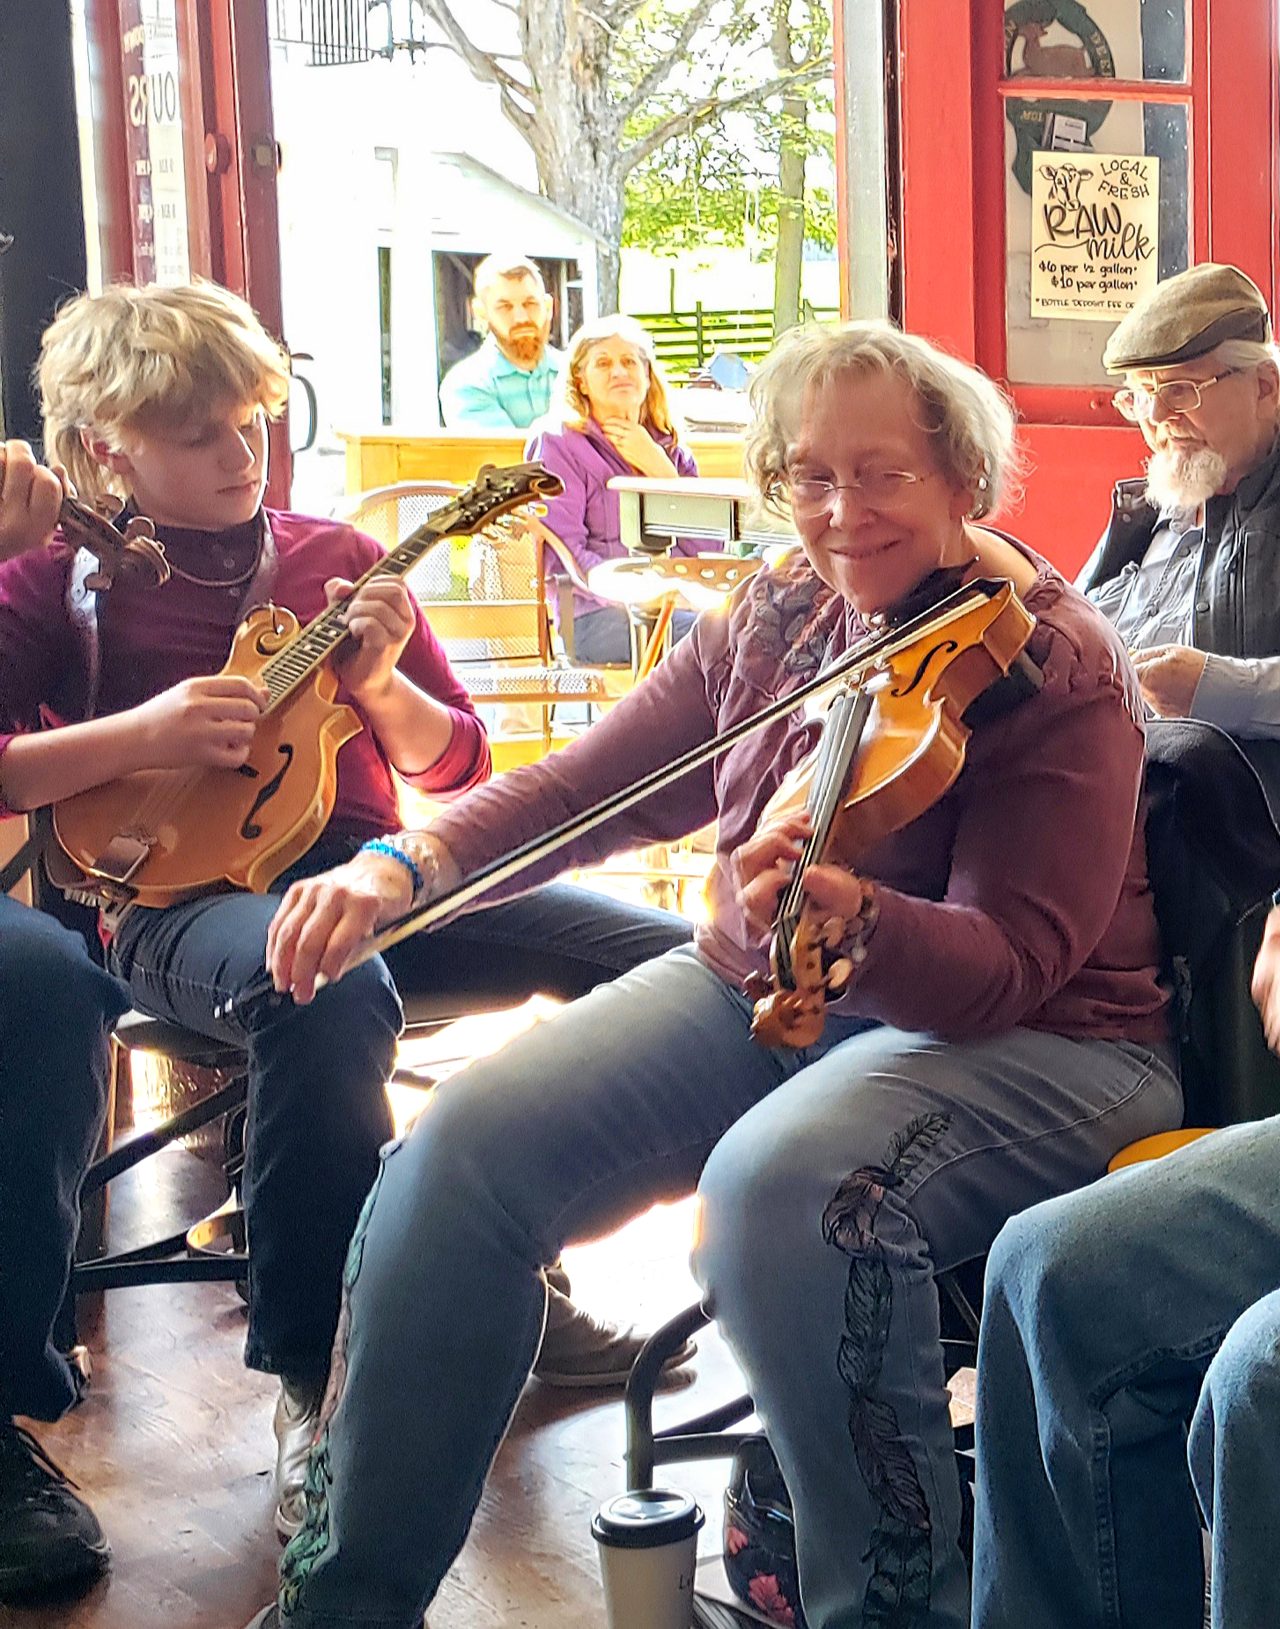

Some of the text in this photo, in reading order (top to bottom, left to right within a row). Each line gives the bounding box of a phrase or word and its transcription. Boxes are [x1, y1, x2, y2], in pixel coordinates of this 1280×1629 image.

[1100, 160, 1148, 180] LOCAL
[1120, 172, 1132, 187] &
[1098, 180, 1150, 199] FRESH
[1044, 202, 1121, 241] RAW
[1086, 223, 1155, 260] milk
[1039, 260, 1057, 272] $6
[1060, 264, 1078, 278] per
[1051, 275, 1073, 289] $10
[1076, 281, 1096, 293] per
[1072, 299, 1105, 308] DEPOSIT
[1108, 301, 1121, 309] FEE
